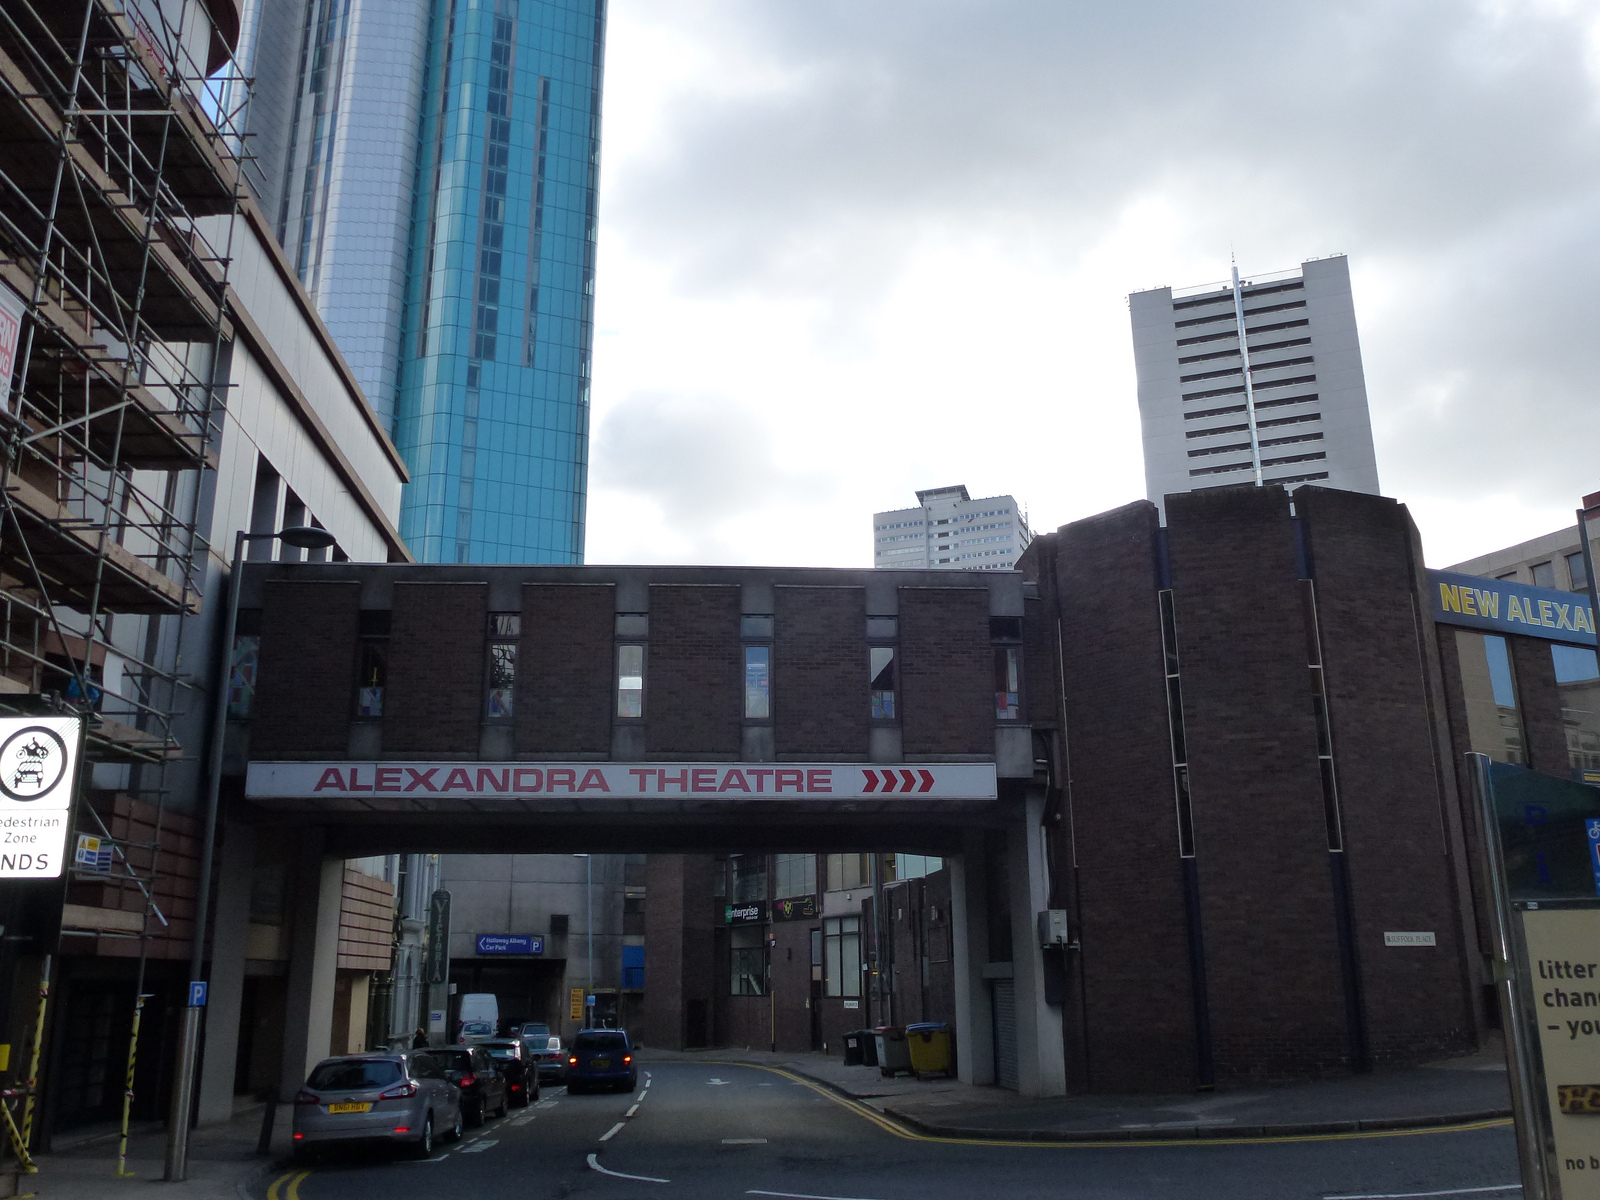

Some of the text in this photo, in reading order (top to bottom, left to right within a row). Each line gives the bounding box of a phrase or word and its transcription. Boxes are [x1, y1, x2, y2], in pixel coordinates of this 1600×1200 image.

[1439, 582, 1499, 619] NEW
[313, 767, 832, 793] ALEXANDRA THEATRE
[4, 831, 37, 844] Zone
[726, 906, 759, 919] enterprise
[532, 941, 540, 952] P
[1538, 960, 1598, 980] litter
[193, 985, 203, 1005] P
[1543, 988, 1600, 1008] chan
[1565, 1159, 1585, 1170] no
